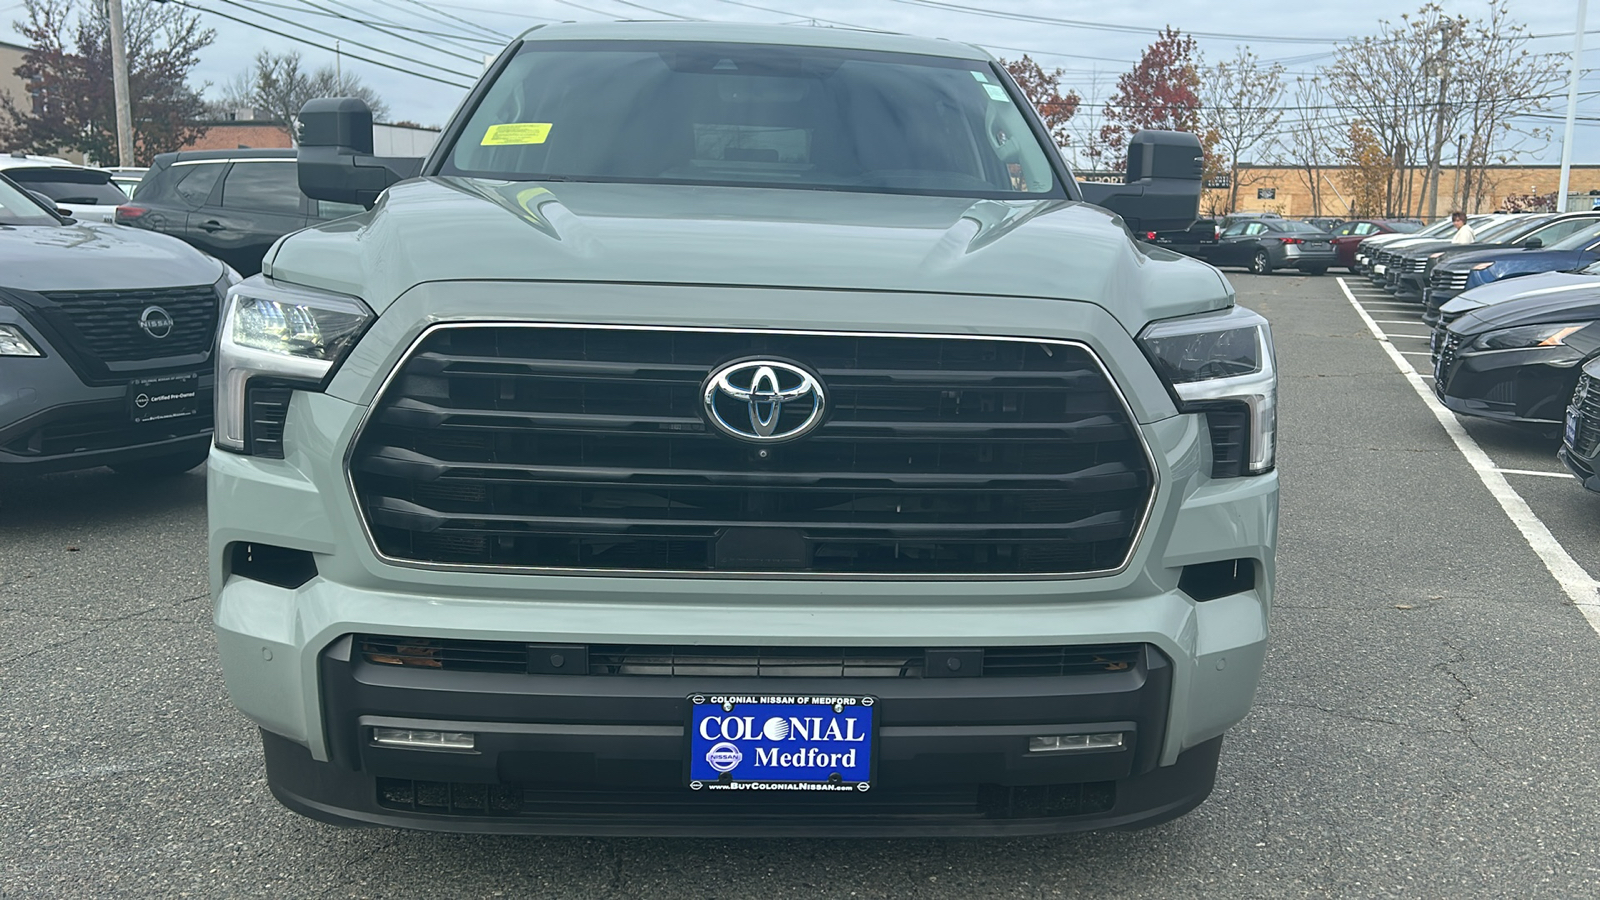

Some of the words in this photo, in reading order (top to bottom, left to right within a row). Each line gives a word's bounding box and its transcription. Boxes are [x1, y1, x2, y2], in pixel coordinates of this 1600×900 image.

[140, 319, 173, 328] NISSAN
[710, 696, 758, 704] COLONIAL
[760, 696, 795, 704] NISSAN
[811, 697, 857, 705] MEDFORD
[700, 715, 865, 742] COLONIAL
[753, 747, 857, 768] Medford
